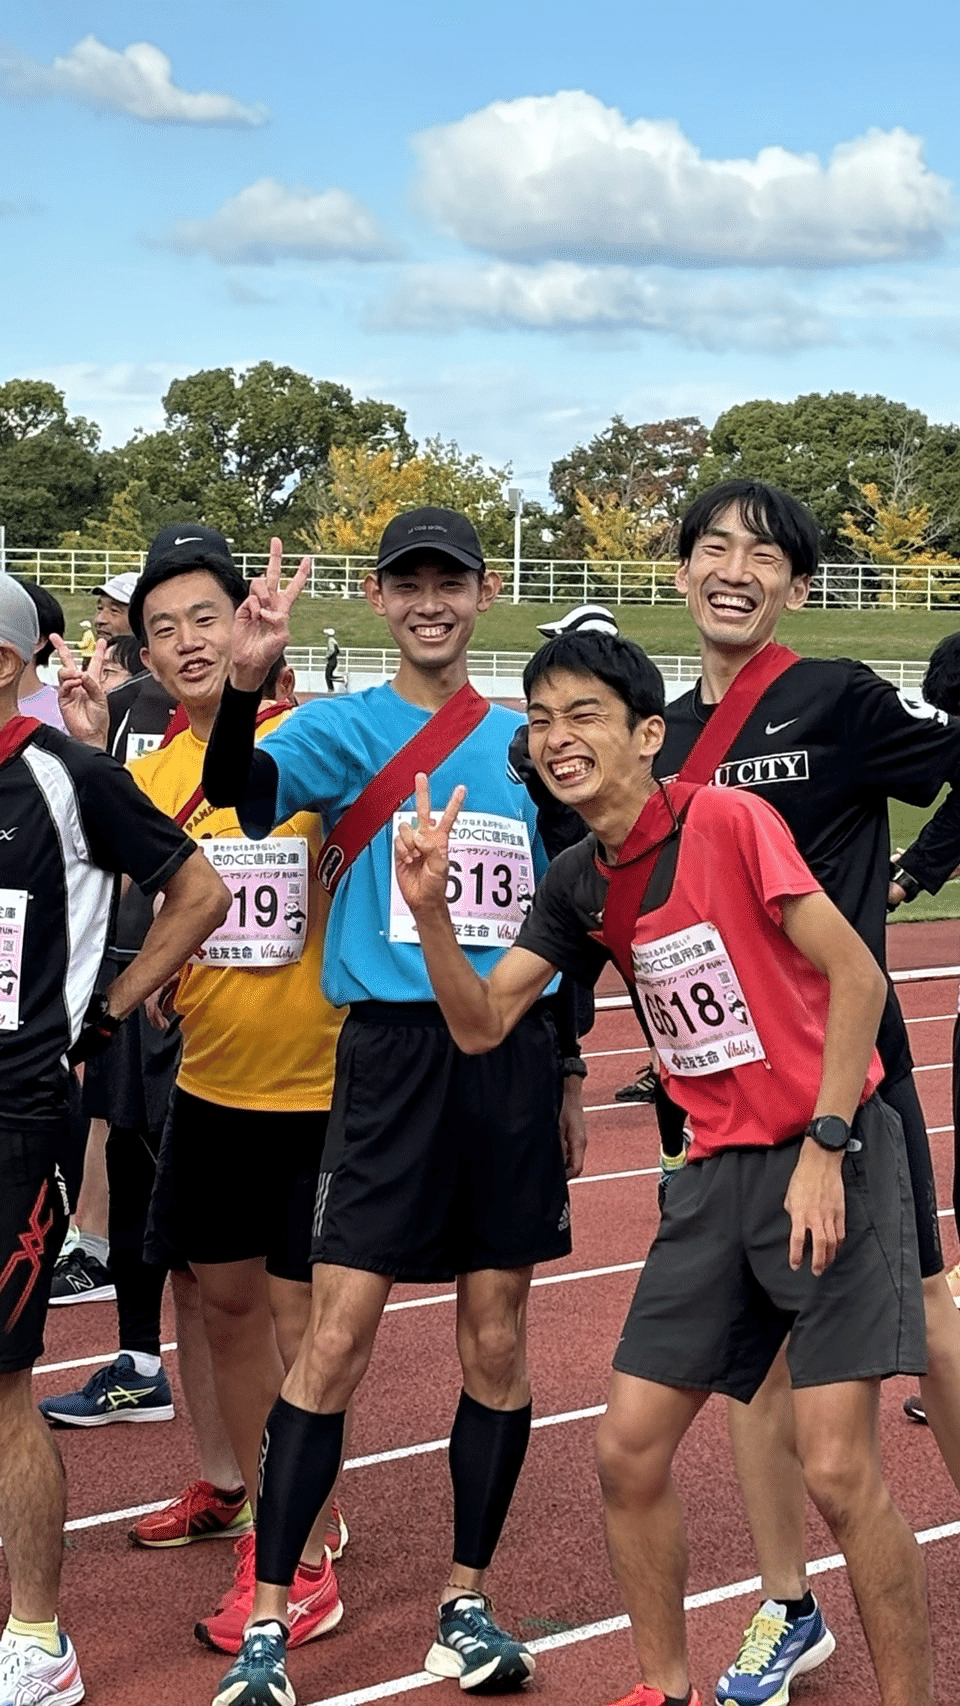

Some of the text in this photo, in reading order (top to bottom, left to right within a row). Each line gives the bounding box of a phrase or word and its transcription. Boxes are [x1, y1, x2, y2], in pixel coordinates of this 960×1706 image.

[737, 755, 801, 783] CITY
[185, 805, 219, 833] PAND
[212, 852, 300, 866] きのくに信用金庫
[446, 860, 513, 908] 613
[233, 884, 278, 928] 19
[208, 945, 253, 959] 住友生命
[644, 982, 725, 1038] G618
